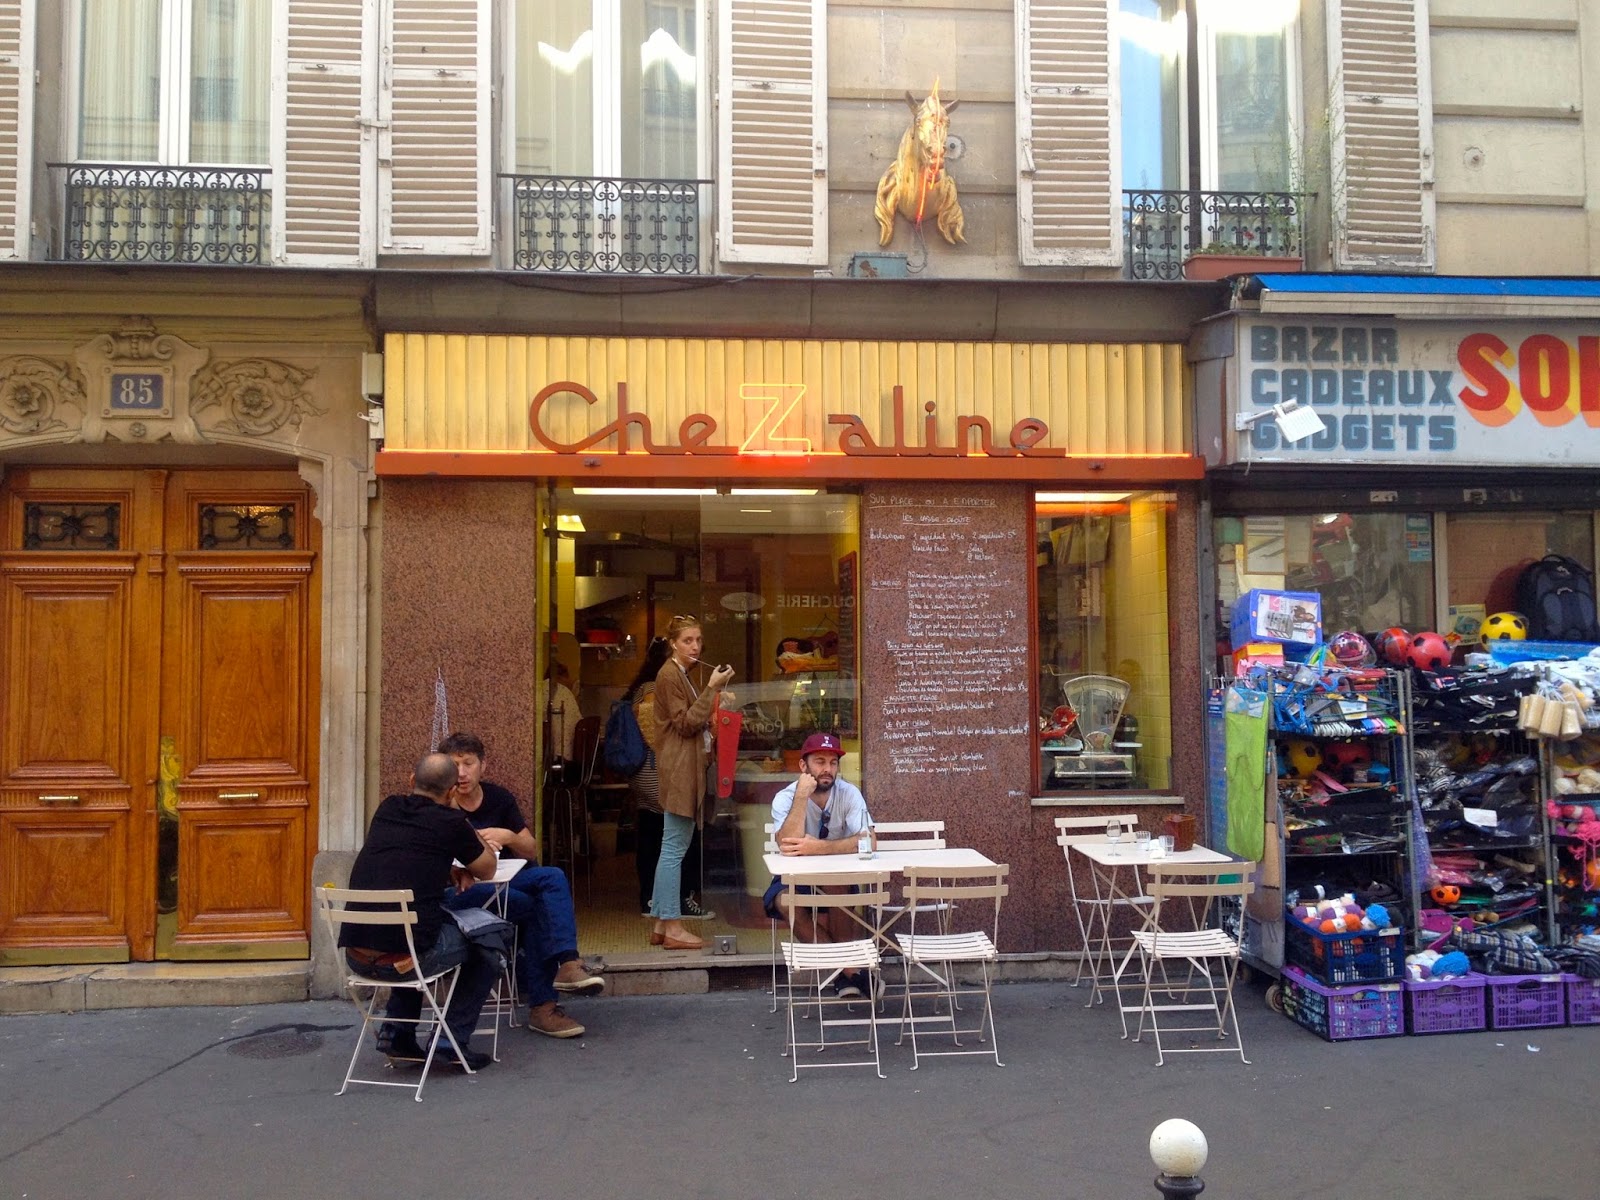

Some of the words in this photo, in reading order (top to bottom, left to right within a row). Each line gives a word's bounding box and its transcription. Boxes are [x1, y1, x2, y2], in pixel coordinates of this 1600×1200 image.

[1250, 326, 1399, 362] BAZAR
[120, 378, 154, 405] 85
[1250, 369, 1457, 406] CADEAUX
[1250, 413, 1457, 451] GDGETS
